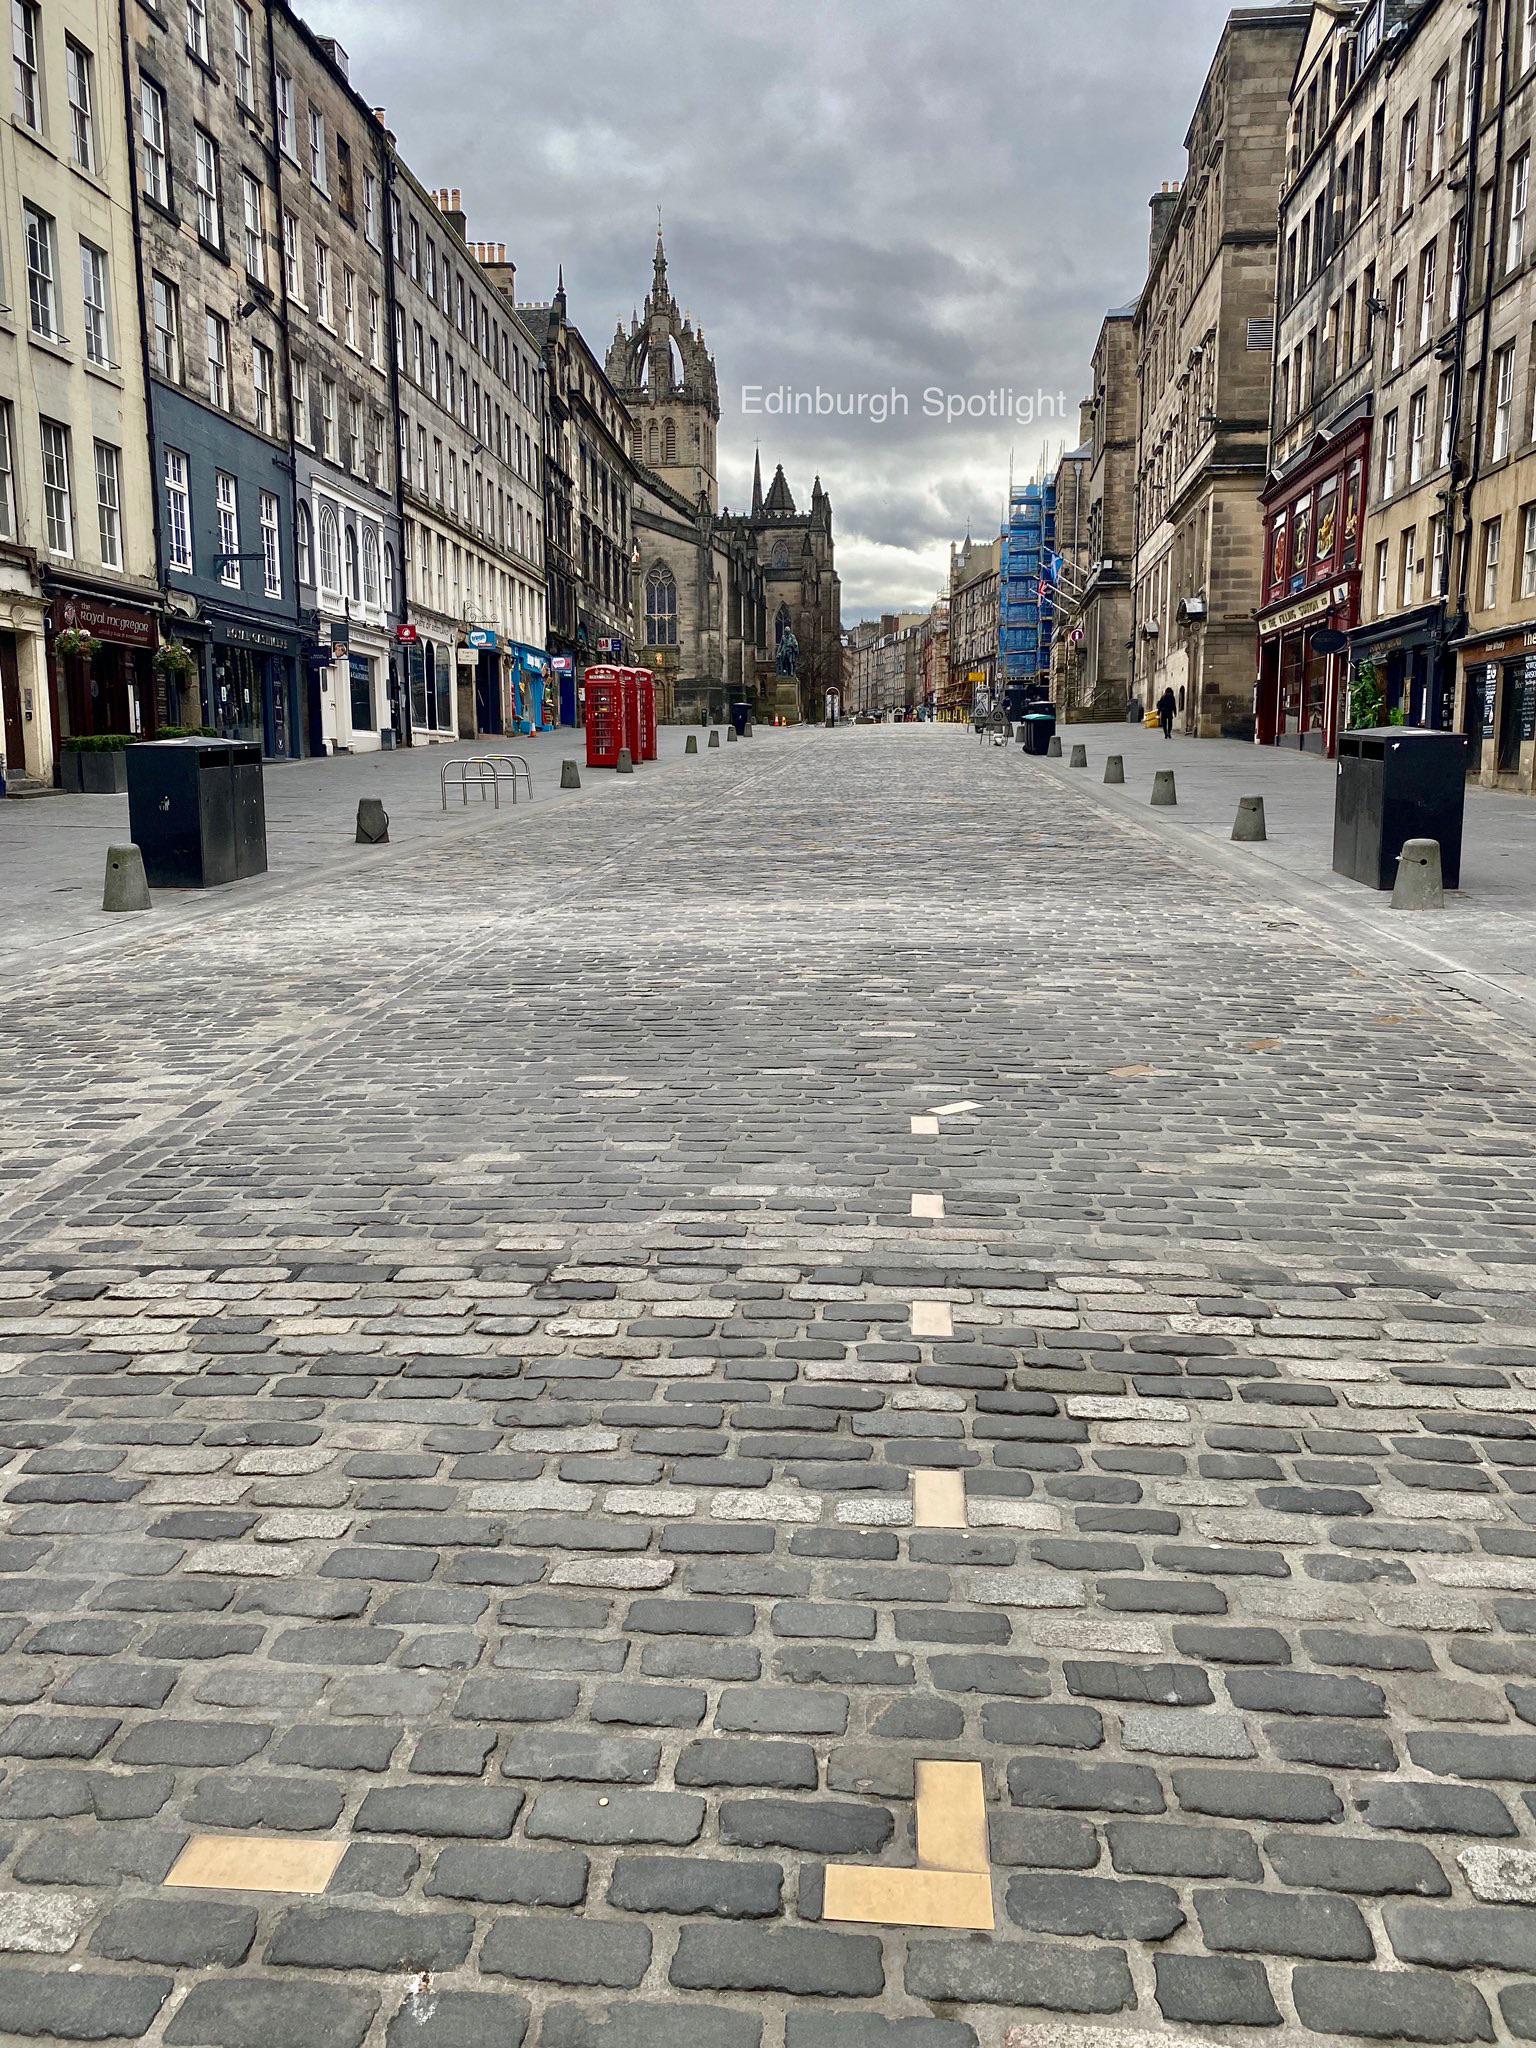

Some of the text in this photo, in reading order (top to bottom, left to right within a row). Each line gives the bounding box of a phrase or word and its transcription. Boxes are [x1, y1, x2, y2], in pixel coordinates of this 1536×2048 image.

[80, 602, 91, 610] the
[1268, 617, 1277, 629] THE
[1279, 609, 1297, 624] FILLING
[1298, 599, 1320, 616] STATION
